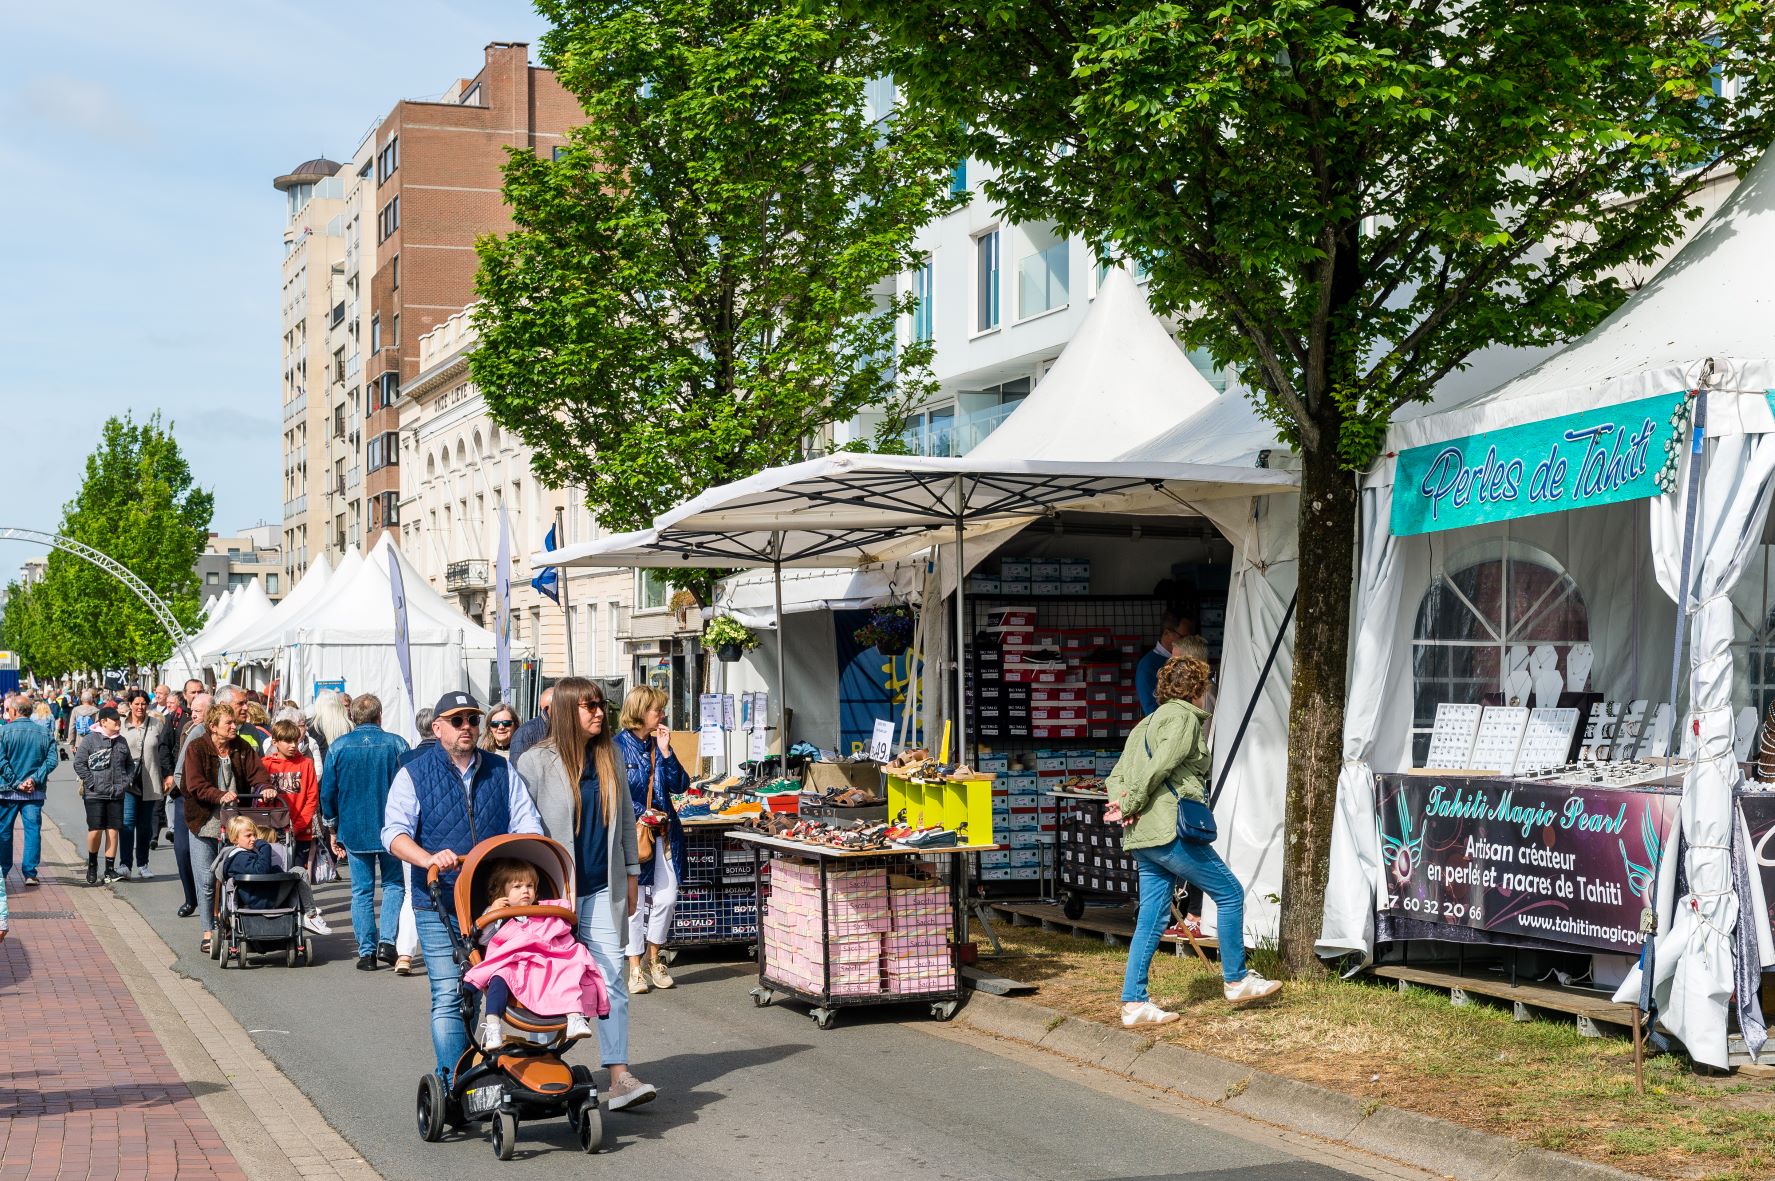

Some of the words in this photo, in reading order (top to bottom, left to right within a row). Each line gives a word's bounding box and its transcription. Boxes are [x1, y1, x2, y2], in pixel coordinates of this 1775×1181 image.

[1421, 445, 1524, 520] Perles
[1529, 444, 1568, 503] de
[1564, 417, 1656, 501] Tahiti
[1426, 786, 1488, 819] Tahiti
[1488, 788, 1556, 838] Magic
[1560, 797, 1627, 835] Pearl
[1465, 835, 1513, 862] Artisan
[1518, 842, 1576, 871] créateur
[1427, 864, 1441, 881] en
[1482, 867, 1497, 887] et
[1502, 873, 1551, 895] nacres
[1555, 875, 1573, 899] de
[1577, 876, 1622, 906] Tahiti
[677, 919, 714, 927] BOTALO
[734, 905, 768, 913] BOTAO
[1403, 897, 1419, 911] 60
[1424, 900, 1438, 914] 32
[1443, 902, 1464, 917] 20
[1469, 906, 1481, 920] 66
